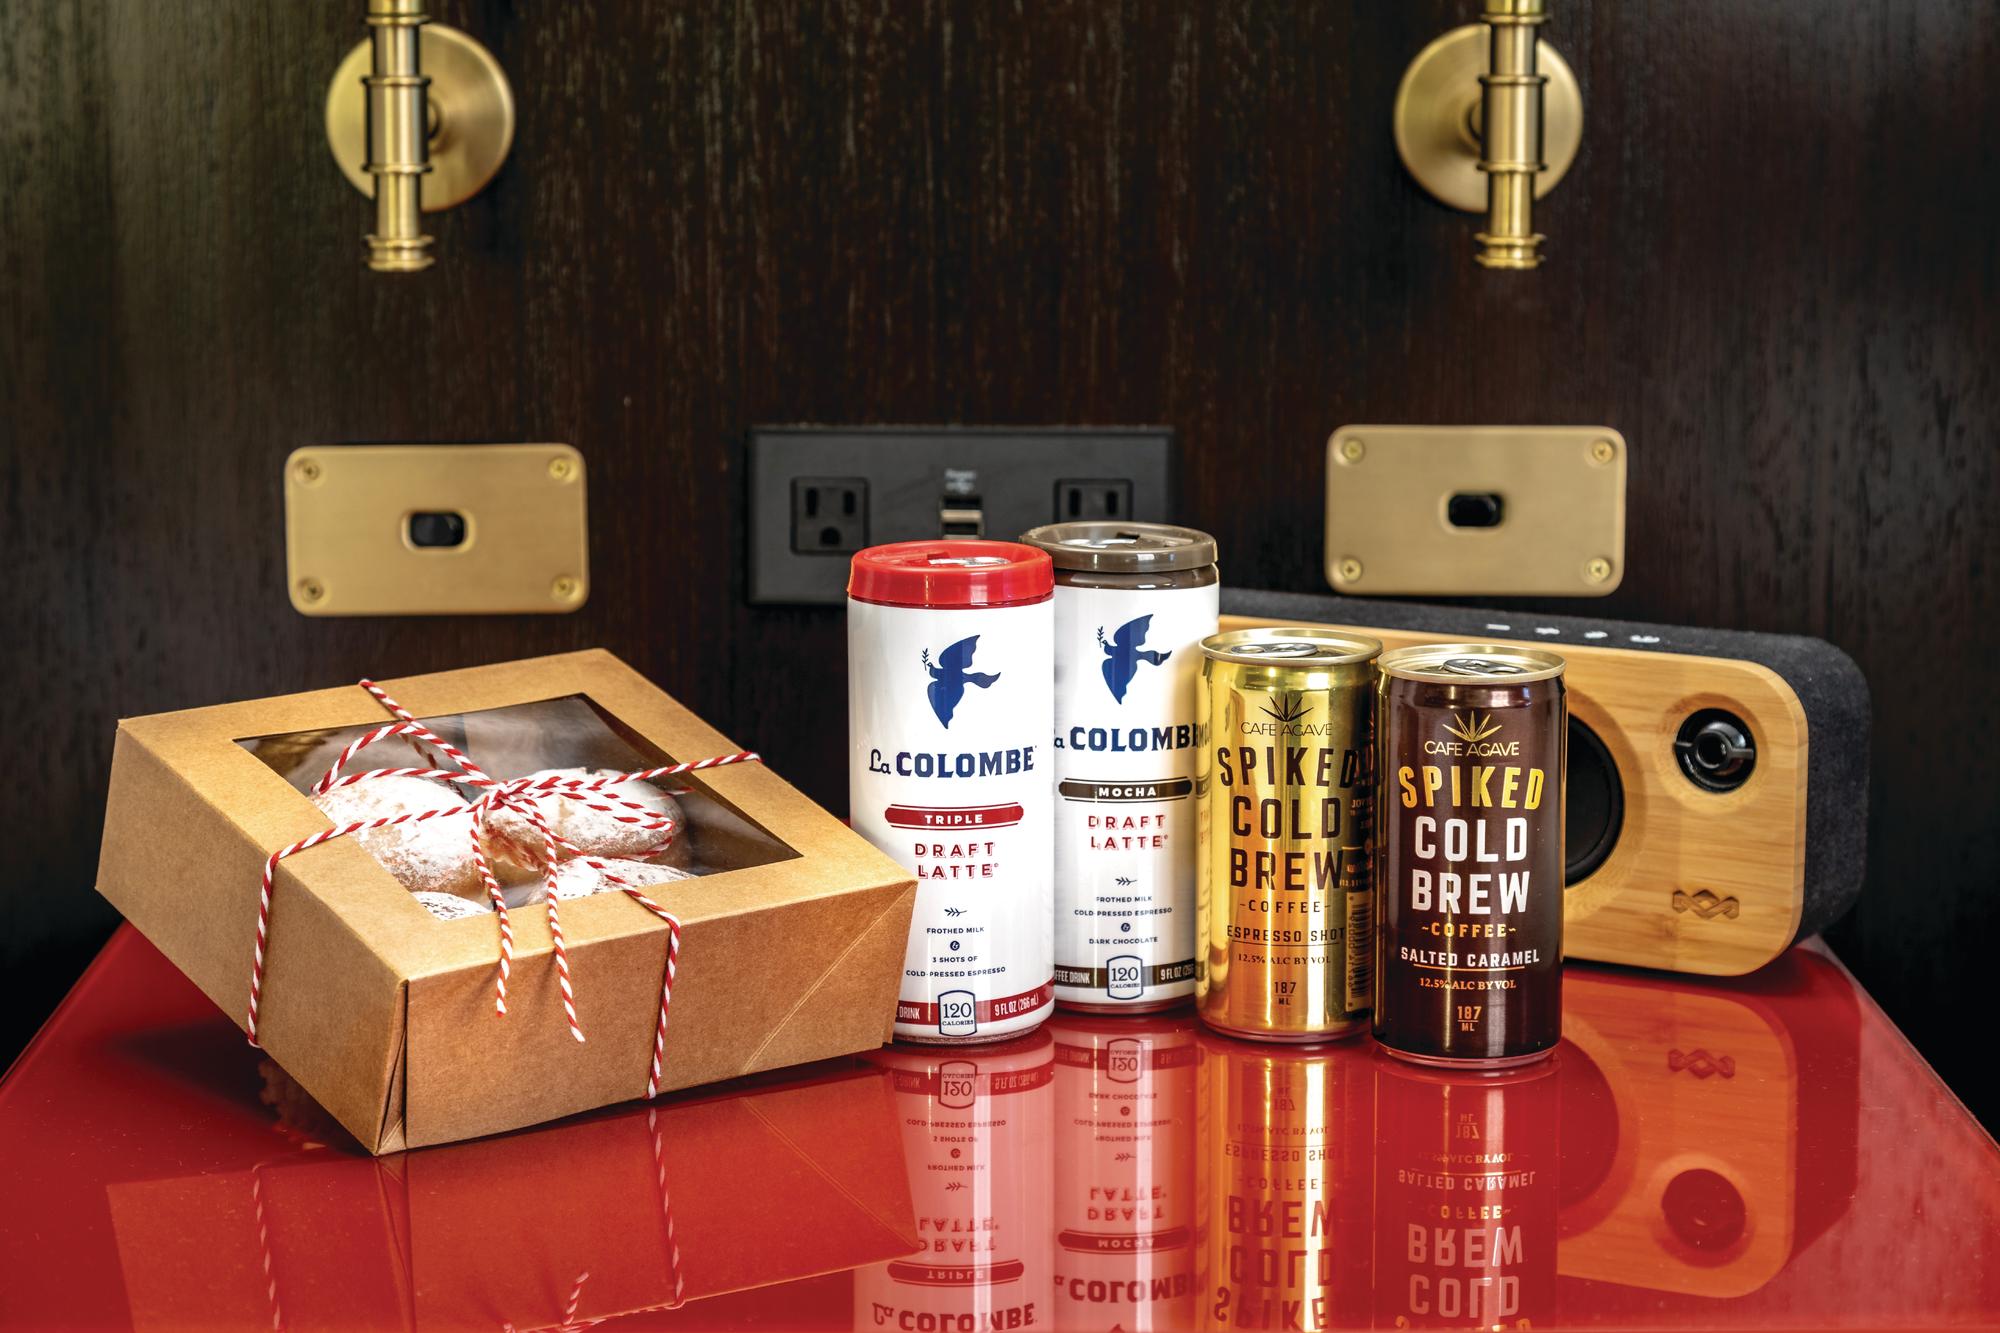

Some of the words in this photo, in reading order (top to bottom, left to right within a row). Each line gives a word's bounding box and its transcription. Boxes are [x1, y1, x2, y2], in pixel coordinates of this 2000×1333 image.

[1241, 722, 1277, 737] CAFE
[1281, 722, 1333, 737] AGAVE
[1054, 737, 1065, 749] a
[1424, 740, 1463, 756] CAFE
[1466, 741, 1520, 756] AGAVE
[869, 748, 891, 774] La
[896, 746, 1035, 778] COLOMBE
[1217, 746, 1358, 788] SPIKED
[1098, 786, 1157, 797] MOCHA
[1398, 765, 1545, 810] SPIKED
[924, 813, 984, 825] TRIPLE
[1088, 814, 1166, 830] DRAFT
[1232, 795, 1342, 840] COLD
[1415, 815, 1528, 863] COLD
[914, 842, 995, 858] DRAFT
[1230, 847, 1344, 891] BREW
[1411, 868, 1531, 915] BREW
[1135, 907, 1172, 916] ESPRESSO
[1112, 936, 1158, 945] CHOCOLATE
[1227, 925, 1302, 943] ESPRESSO
[1311, 927, 1345, 942] SHOT
[1237, 953, 1266, 964] 12.5%
[1270, 956, 1291, 965] ALC
[1294, 956, 1309, 965] BY
[1310, 955, 1331, 964] VOL
[1401, 946, 1458, 967] SALTED
[1467, 949, 1540, 968] CARAMEL
[967, 966, 1006, 977] ESPRESSO
[1069, 971, 1090, 984] DRINK
[1111, 966, 1139, 982] 120
[1160, 969, 1166, 981] 9
[1166, 968, 1174, 979] FL
[1174, 967, 1181, 978] OZ
[1274, 981, 1297, 994] 187
[1419, 977, 1450, 989] 12.5%
[1452, 980, 1475, 990] ALC
[1478, 981, 1492, 990] BY
[1493, 979, 1517, 990] VOL
[994, 1003, 1001, 1017] 9
[1001, 1002, 1008, 1015] FL
[1008, 1000, 1018, 1013] OZ
[1278, 997, 1291, 1006] ML
[899, 1005, 921, 1020] DRINK
[943, 1002, 972, 1019] 120
[1457, 1005, 1482, 1020] 187
[1461, 1022, 1475, 1032] ML
